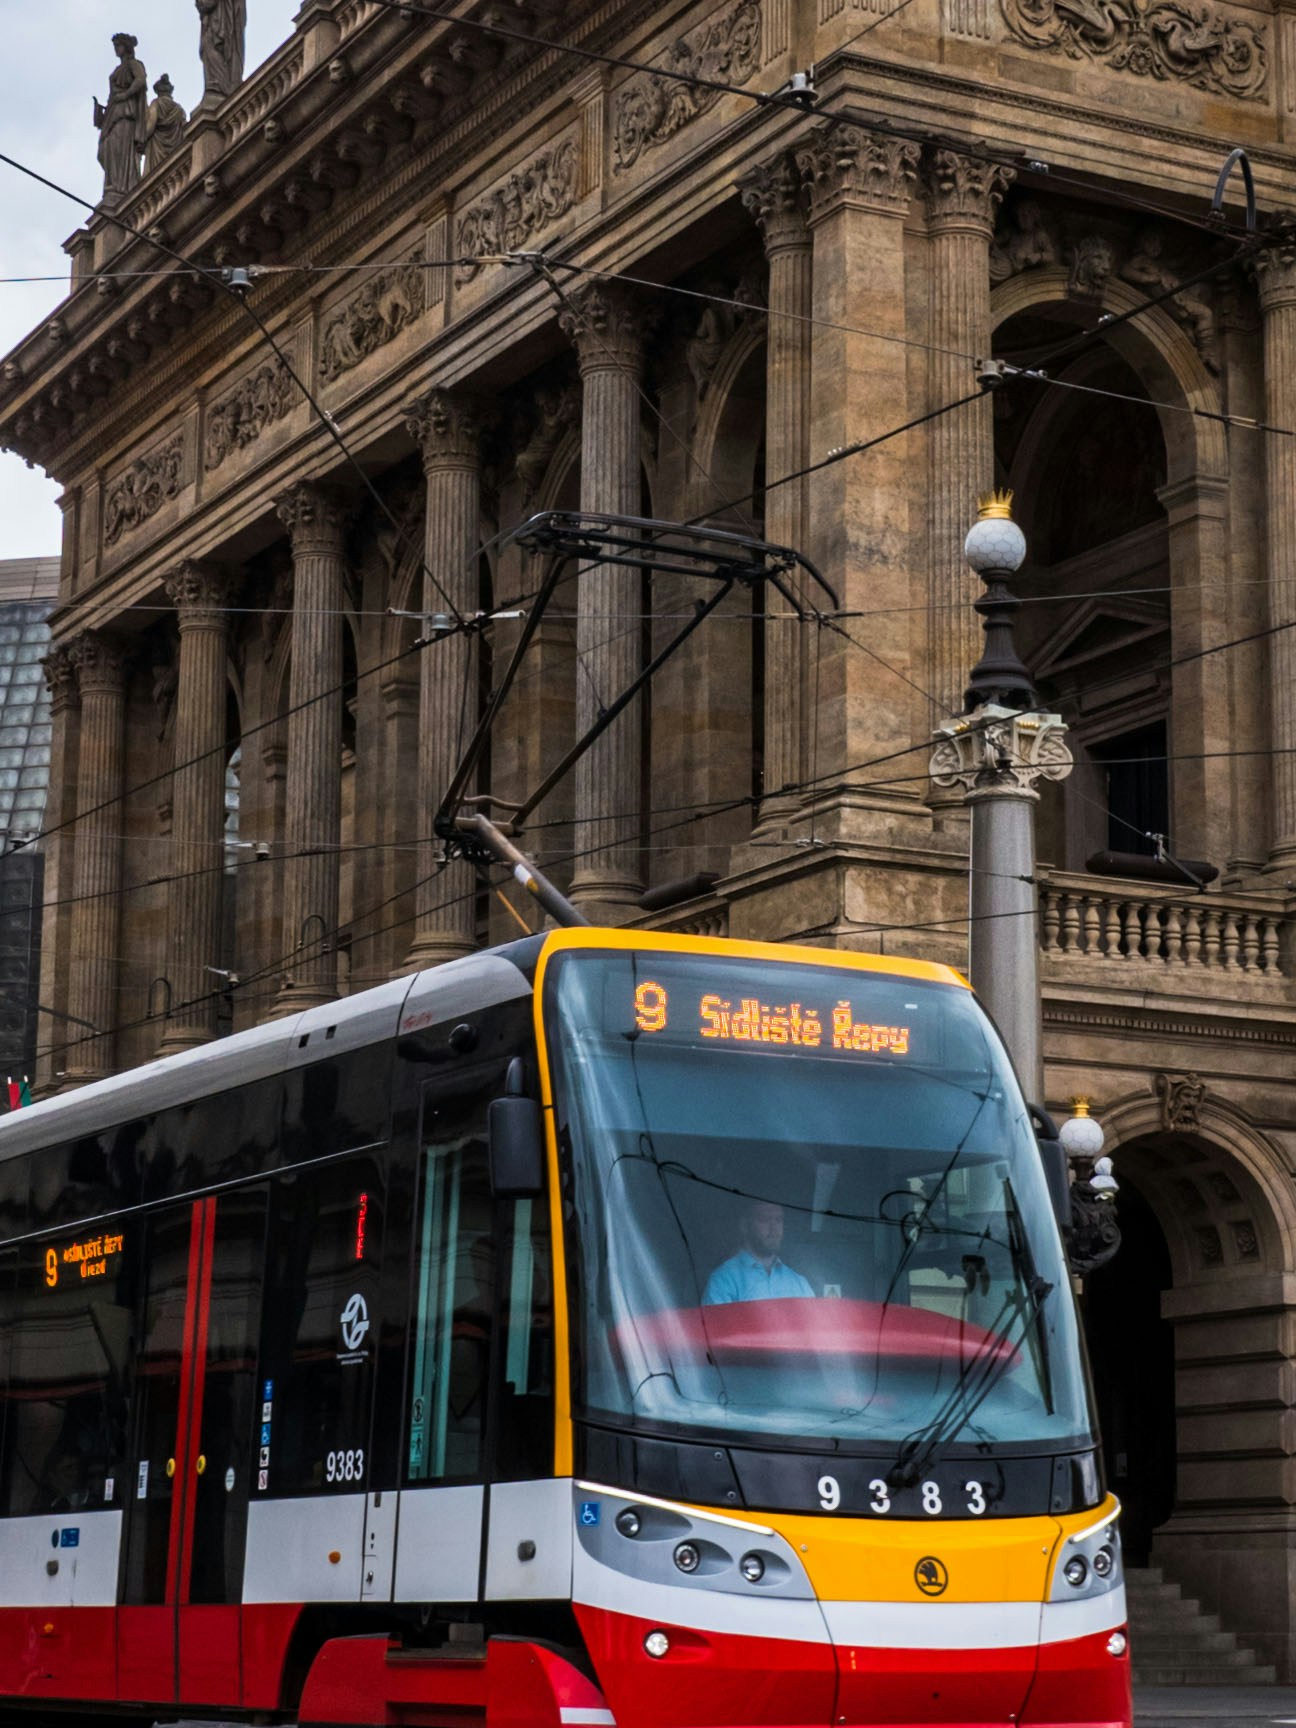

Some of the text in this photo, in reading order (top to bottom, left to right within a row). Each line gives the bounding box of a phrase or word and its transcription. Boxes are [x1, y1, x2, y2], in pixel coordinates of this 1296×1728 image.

[634, 981, 909, 1054] 9 Sídliště Řepy
[46, 1248, 58, 1287] 9
[326, 1448, 364, 1482] 9383
[817, 1475, 986, 1515] 9383
